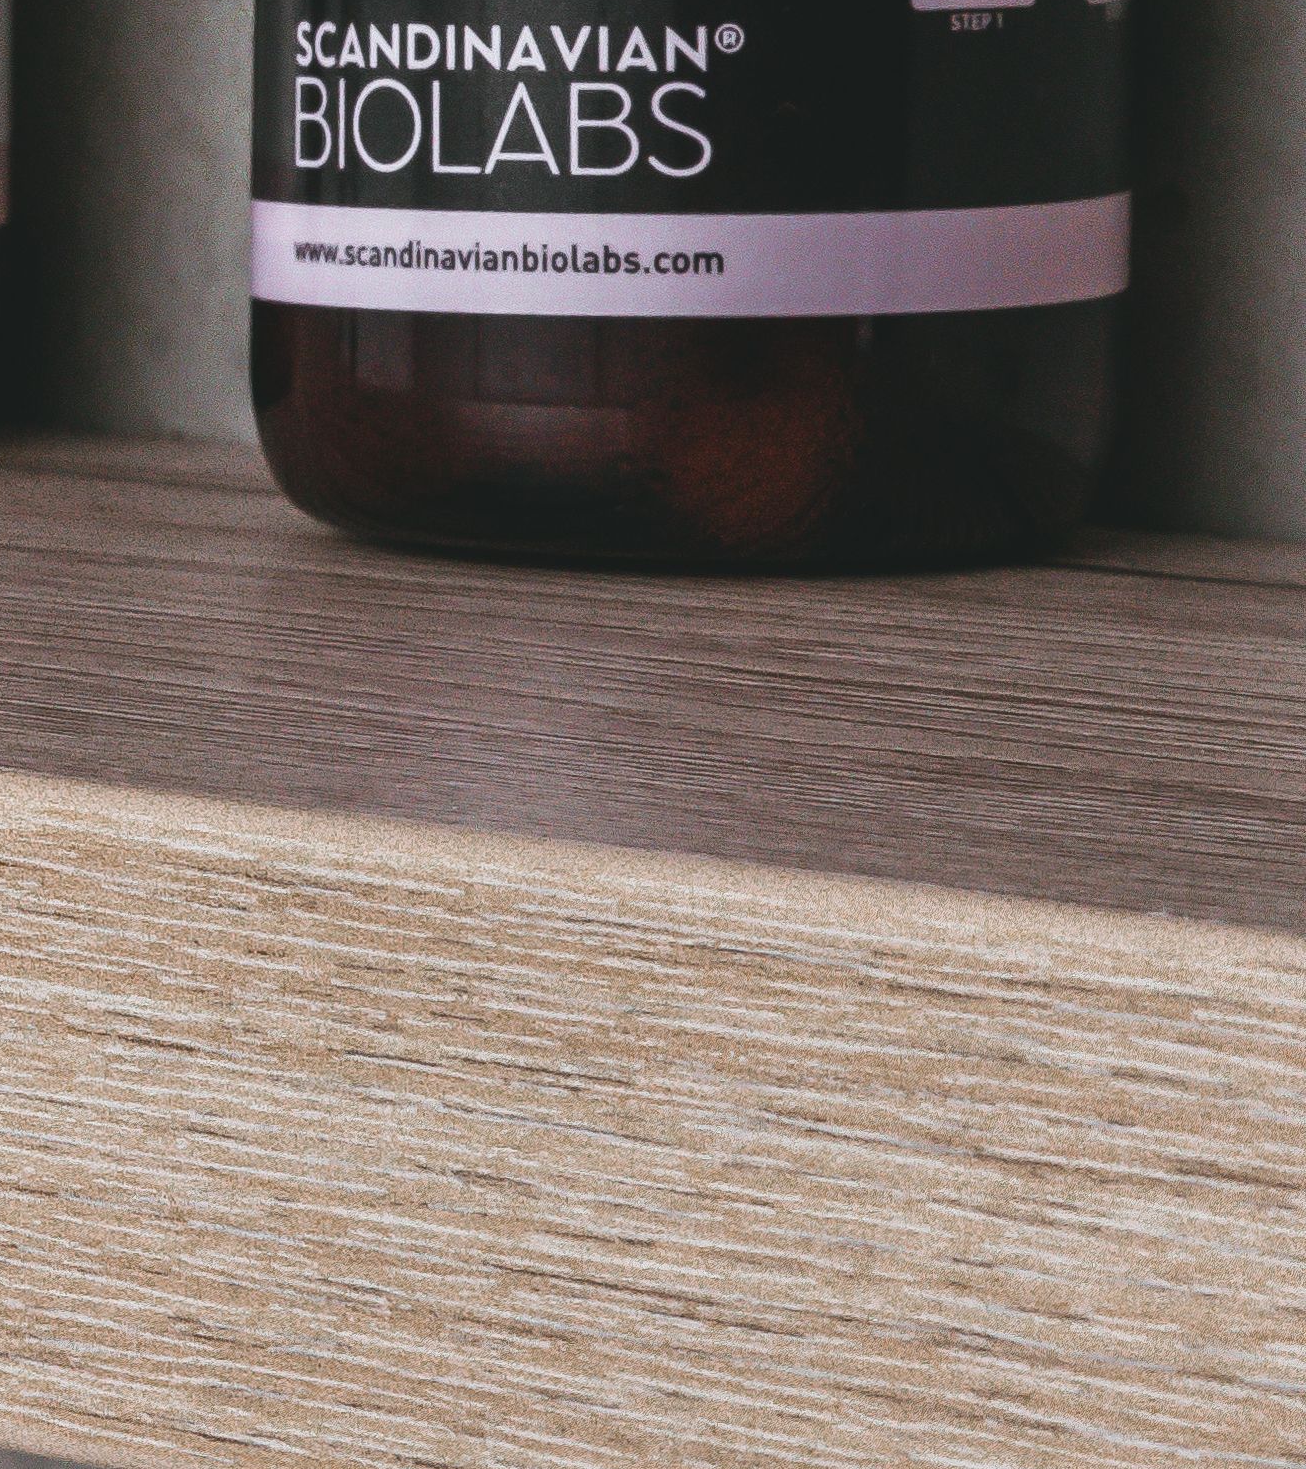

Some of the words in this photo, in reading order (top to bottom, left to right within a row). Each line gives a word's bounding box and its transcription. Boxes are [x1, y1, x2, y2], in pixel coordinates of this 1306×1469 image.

[949, 12, 992, 32] STEP
[294, 76, 712, 177] BIOLABS
[293, 239, 725, 276] www.scandinavianbiolabs.com
